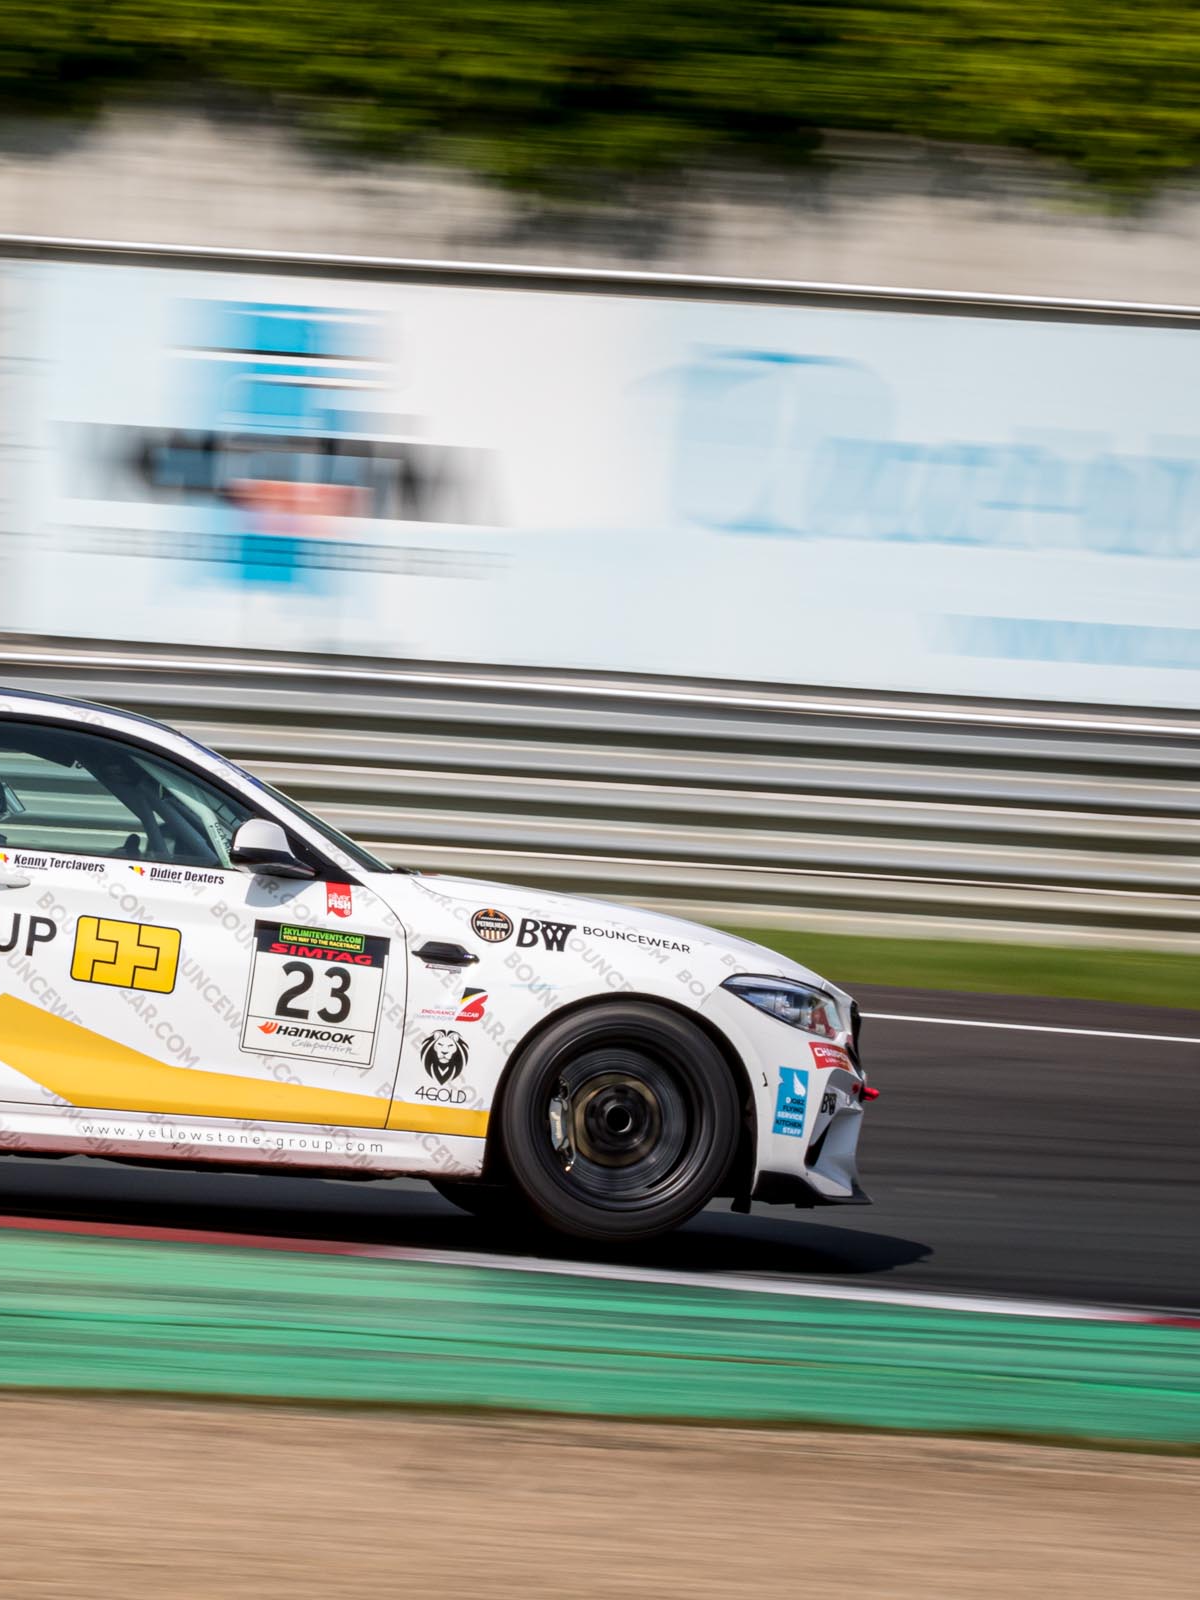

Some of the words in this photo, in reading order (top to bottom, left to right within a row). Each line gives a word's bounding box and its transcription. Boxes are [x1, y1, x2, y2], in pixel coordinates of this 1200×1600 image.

[13, 854, 48, 867] Kenny
[49, 857, 106, 872] Terclavers
[150, 867, 183, 880] Didier
[184, 871, 225, 885] Dexters
[328, 899, 351, 910] FISH
[282, 927, 362, 945] SKYLIMITEVENTS.COM
[319, 939, 329, 947] THE
[516, 918, 577, 952] BW
[583, 926, 691, 954] BOUNCEWEAR
[269, 943, 373, 966] SIMTAG
[275, 961, 351, 1024] 23
[415, 1085, 468, 1104] 4GOLD
[82, 1124, 384, 1153] www.yellowstone-group.com
